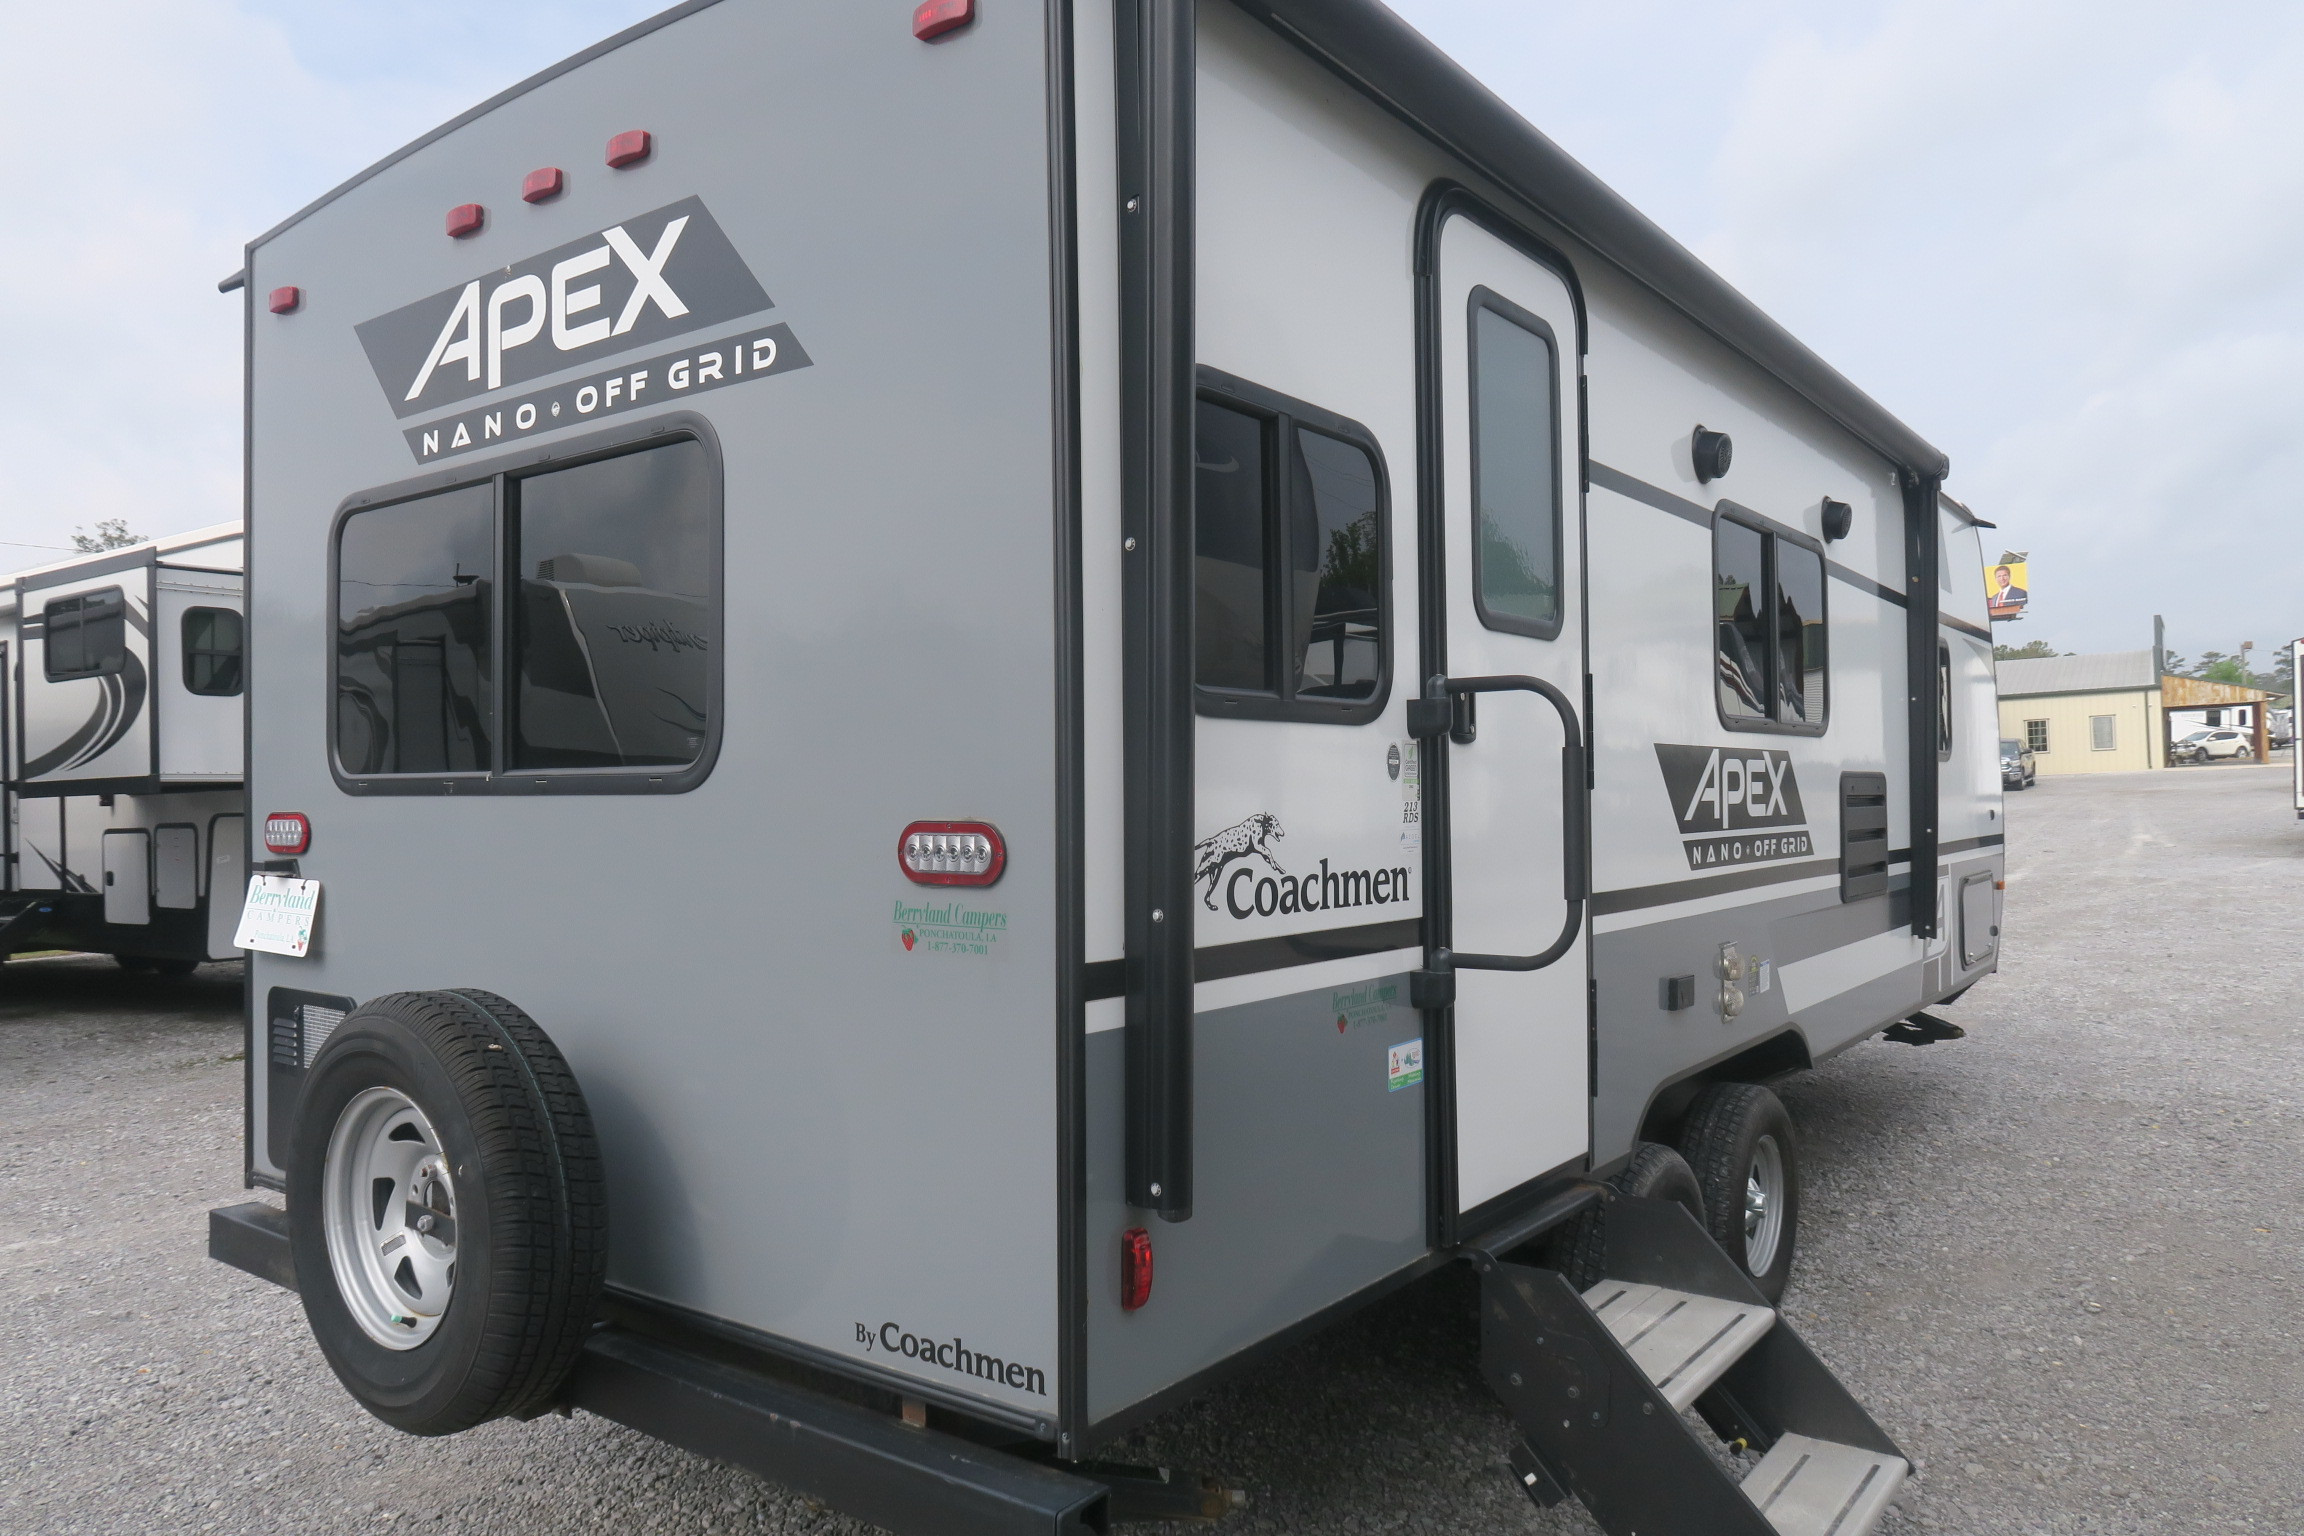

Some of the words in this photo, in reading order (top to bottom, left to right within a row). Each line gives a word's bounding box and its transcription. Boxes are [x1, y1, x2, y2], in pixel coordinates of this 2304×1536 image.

[404, 215, 690, 402] APEX
[423, 404, 536, 456] NANO
[575, 370, 649, 415] OFF
[668, 338, 777, 388] GRID
[1683, 748, 1789, 829] APEX
[1402, 812, 1419, 823] RDS
[1403, 801, 1418, 812] 213
[1693, 841, 1742, 865] NANO
[1754, 838, 1777, 857] OFF
[1781, 836, 1808, 854] GRID
[249, 884, 316, 910] Berryland
[1226, 858, 1410, 920] Coachmen
[247, 909, 310, 927] CAMPERS
[893, 900, 952, 925] Berryland
[954, 903, 1008, 932] Campers
[855, 1322, 876, 1351] By
[879, 1321, 1047, 1396] Coachmen
